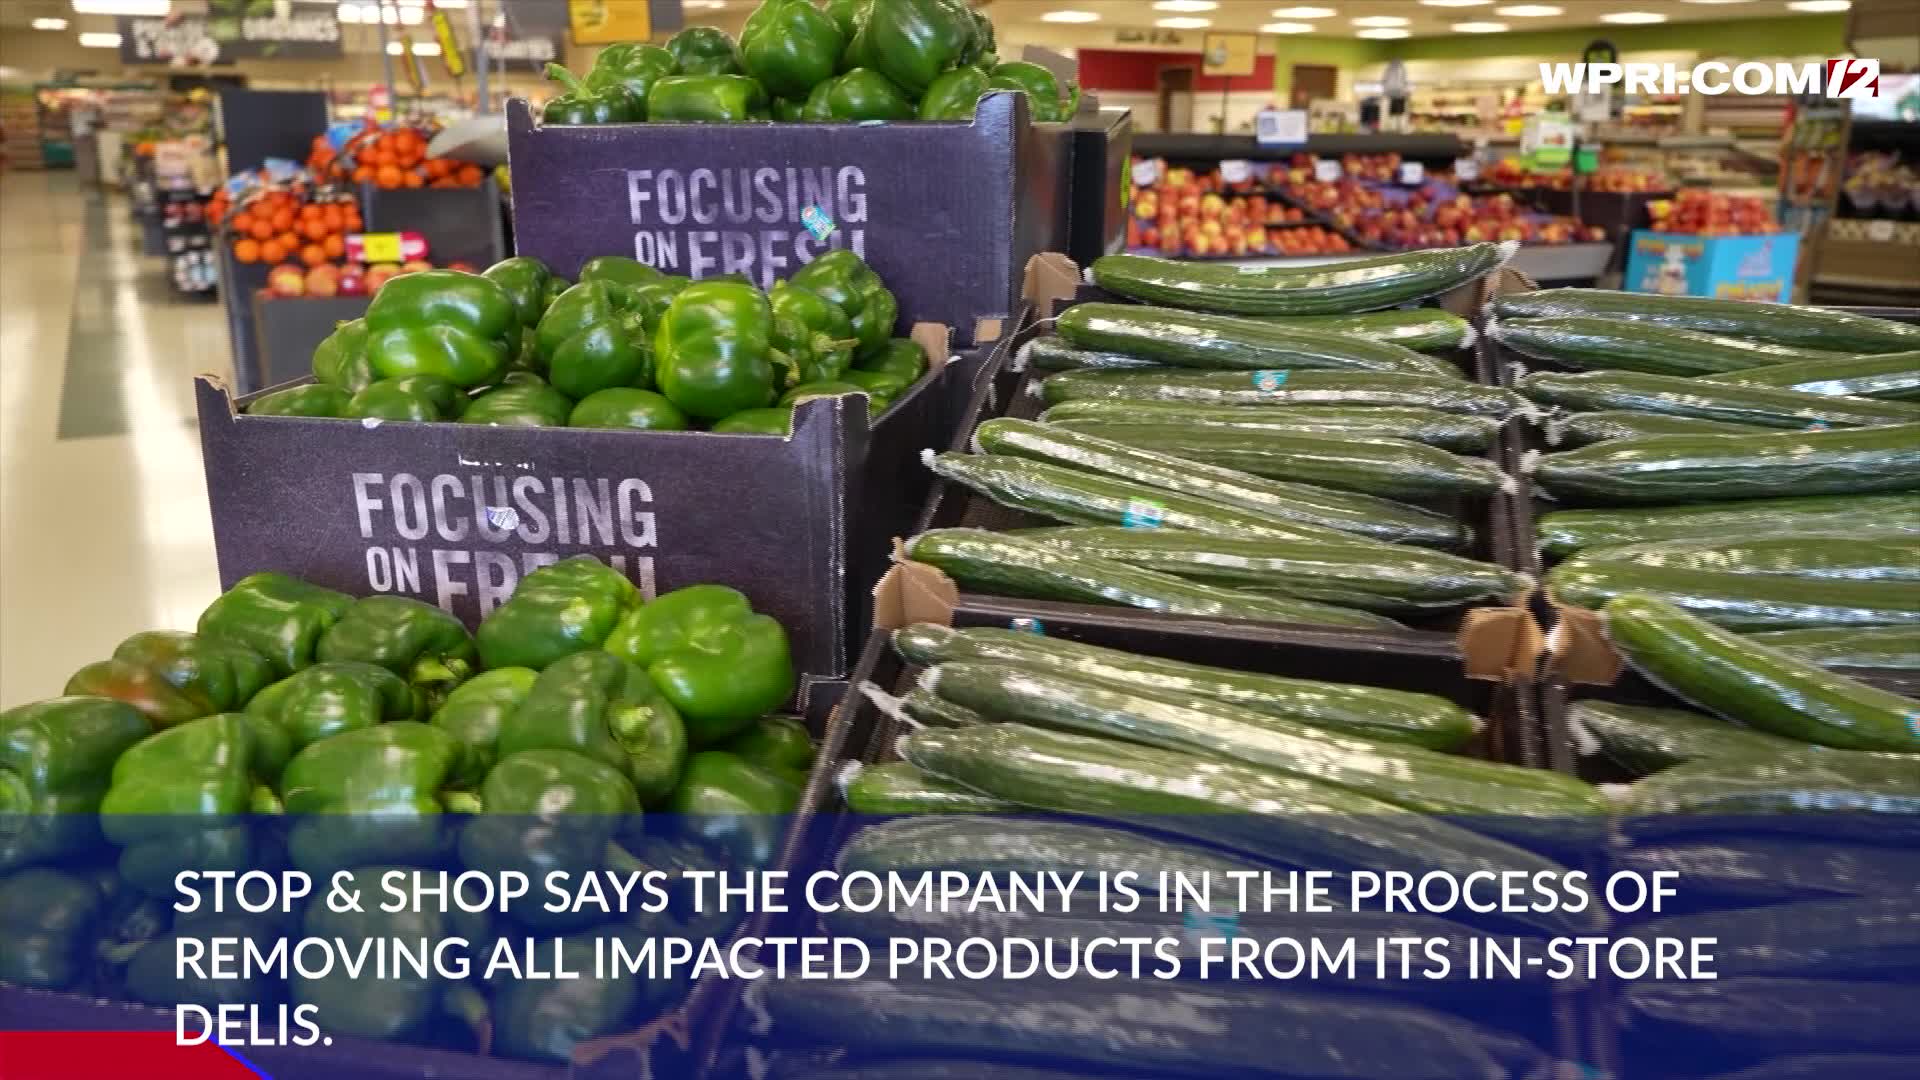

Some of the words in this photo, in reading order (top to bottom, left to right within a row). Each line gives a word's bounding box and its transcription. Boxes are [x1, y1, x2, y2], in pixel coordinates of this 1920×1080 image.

[627, 166, 867, 226] FOCUSING
[634, 231, 679, 269] ON
[688, 230, 865, 291] FRE
[353, 473, 657, 547] FOCUSING
[366, 546, 421, 593] ON
